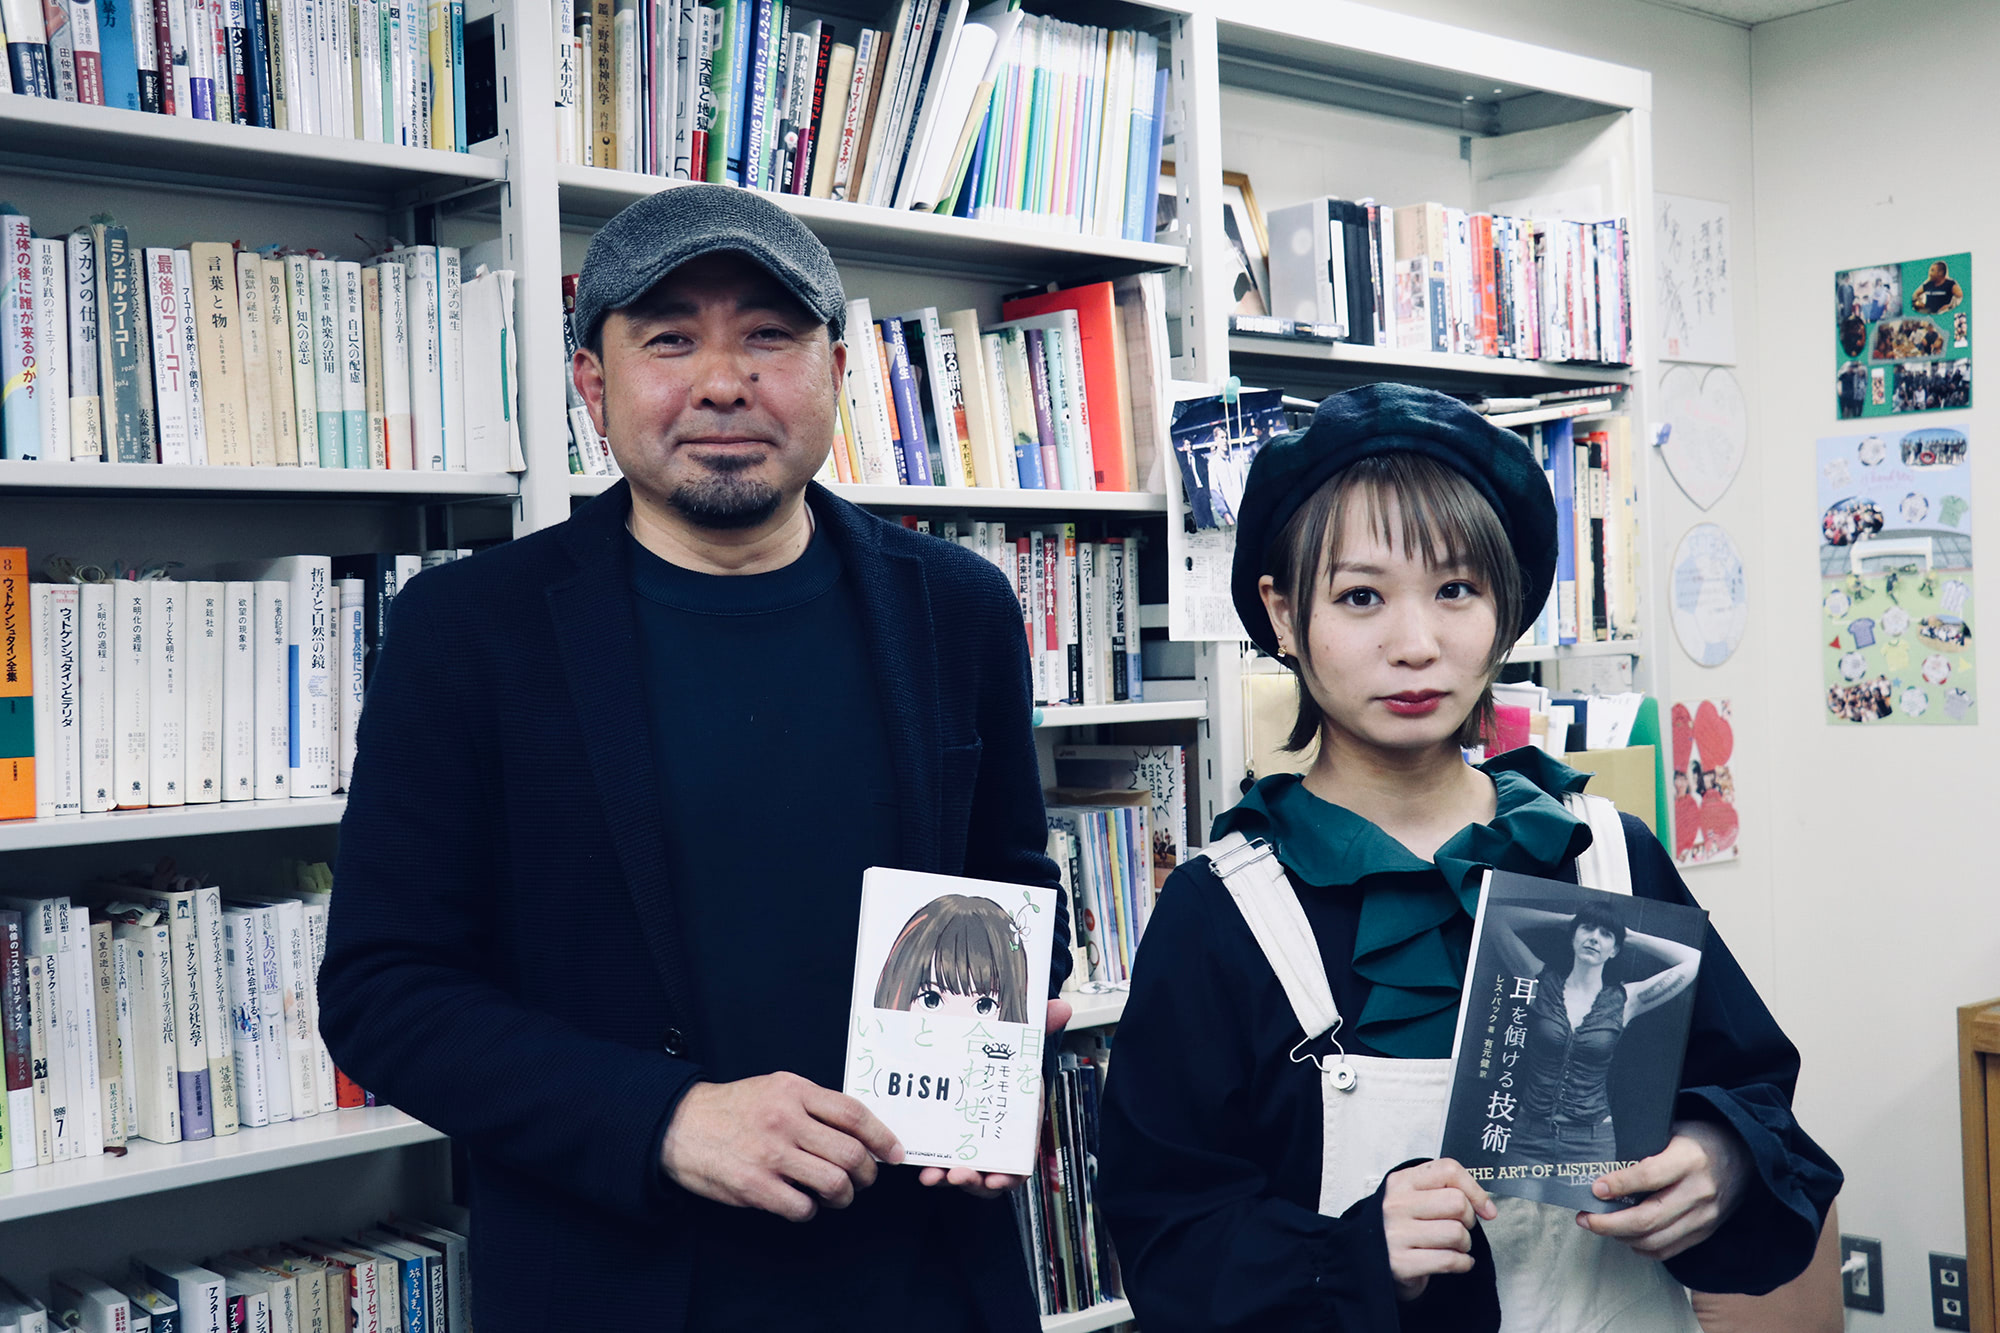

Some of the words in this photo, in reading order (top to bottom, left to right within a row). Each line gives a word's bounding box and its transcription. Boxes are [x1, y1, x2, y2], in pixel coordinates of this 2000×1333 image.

[560, 0, 571, 34] 友佑都
[560, 44, 573, 105] 日本男児
[697, 58, 712, 132] 天国と地獄
[754, 93, 766, 119] THE
[812, 34, 831, 120] フットボールサミット
[746, 120, 763, 182] COACHING
[16, 222, 37, 399] 主体の後に誰が来るのか?
[41, 244, 57, 377] 日常的実践のポイエティーク
[79, 237, 97, 343] ラカンの仕事
[110, 239, 130, 358] ミシェル・フーコー
[157, 254, 181, 393] 最後のフーコー
[207, 256, 228, 329] 言葉と物
[244, 268, 259, 323] 監獄の誕生
[269, 275, 283, 325] 知の考古学
[447, 256, 461, 331] 臨床医学の誕生
[296, 310, 312, 365] 知への意志
[321, 315, 335, 374] 快楽の活用
[348, 319, 361, 384] 自己への配慮
[940, 334, 964, 408] 蹴る群れ
[4, 559, 12, 571] 8
[384, 569, 397, 600] 振動
[1019, 556, 1029, 594] 未来世紀
[1114, 556, 1126, 634] フーリガン戦記
[3, 577, 17, 683] ウィトゲンシュタイン全集
[97, 602, 107, 673] 文明化の過程・上
[133, 597, 142, 666] 文明化の過程・下
[165, 597, 175, 663] スポーツと文明化
[205, 598, 215, 639] 宮廷社会
[238, 597, 248, 653] 欲望の現象学
[274, 597, 284, 646] 他者の記号学
[311, 567, 326, 669] 哲学と自然の鏡
[60, 607, 73, 728] ウィトゲンシュタインとデリダ
[352, 609, 363, 703] 自己言及性について
[43, 904, 52, 934] 現代思想
[59, 902, 69, 938] 現代思想
[8, 923, 24, 1031] 映像のコスモポリティクス
[46, 955, 56, 990] スピヴァク
[98, 932, 110, 994] 天皇の逝く国で
[118, 944, 127, 990] フェミニズム入門
[186, 942, 202, 1047] セクシュアリティの社会学
[211, 920, 226, 1012] ナショナリズムとセクシュアリティ
[244, 918, 259, 1017] ファッションで社会学する
[262, 935, 279, 991] 美の陰謀
[291, 928, 306, 1040] 美容整形と化粧の社会学
[159, 951, 174, 1044] セクシュアリティの近代
[1017, 1027, 1042, 1094] 目を
[1481, 976, 1539, 1154] 耳を傾ける技術
[54, 1106, 66, 1117] 1999
[56, 1119, 64, 1138] 7
[980, 1063, 996, 1139] カンパニー
[995, 1064, 1010, 1140] モモコグミ
[1464, 1167, 1494, 1181] THE
[1497, 1166, 1530, 1180] ART
[1531, 1164, 1555, 1178] OF
[1570, 1174, 1596, 1187] LES
